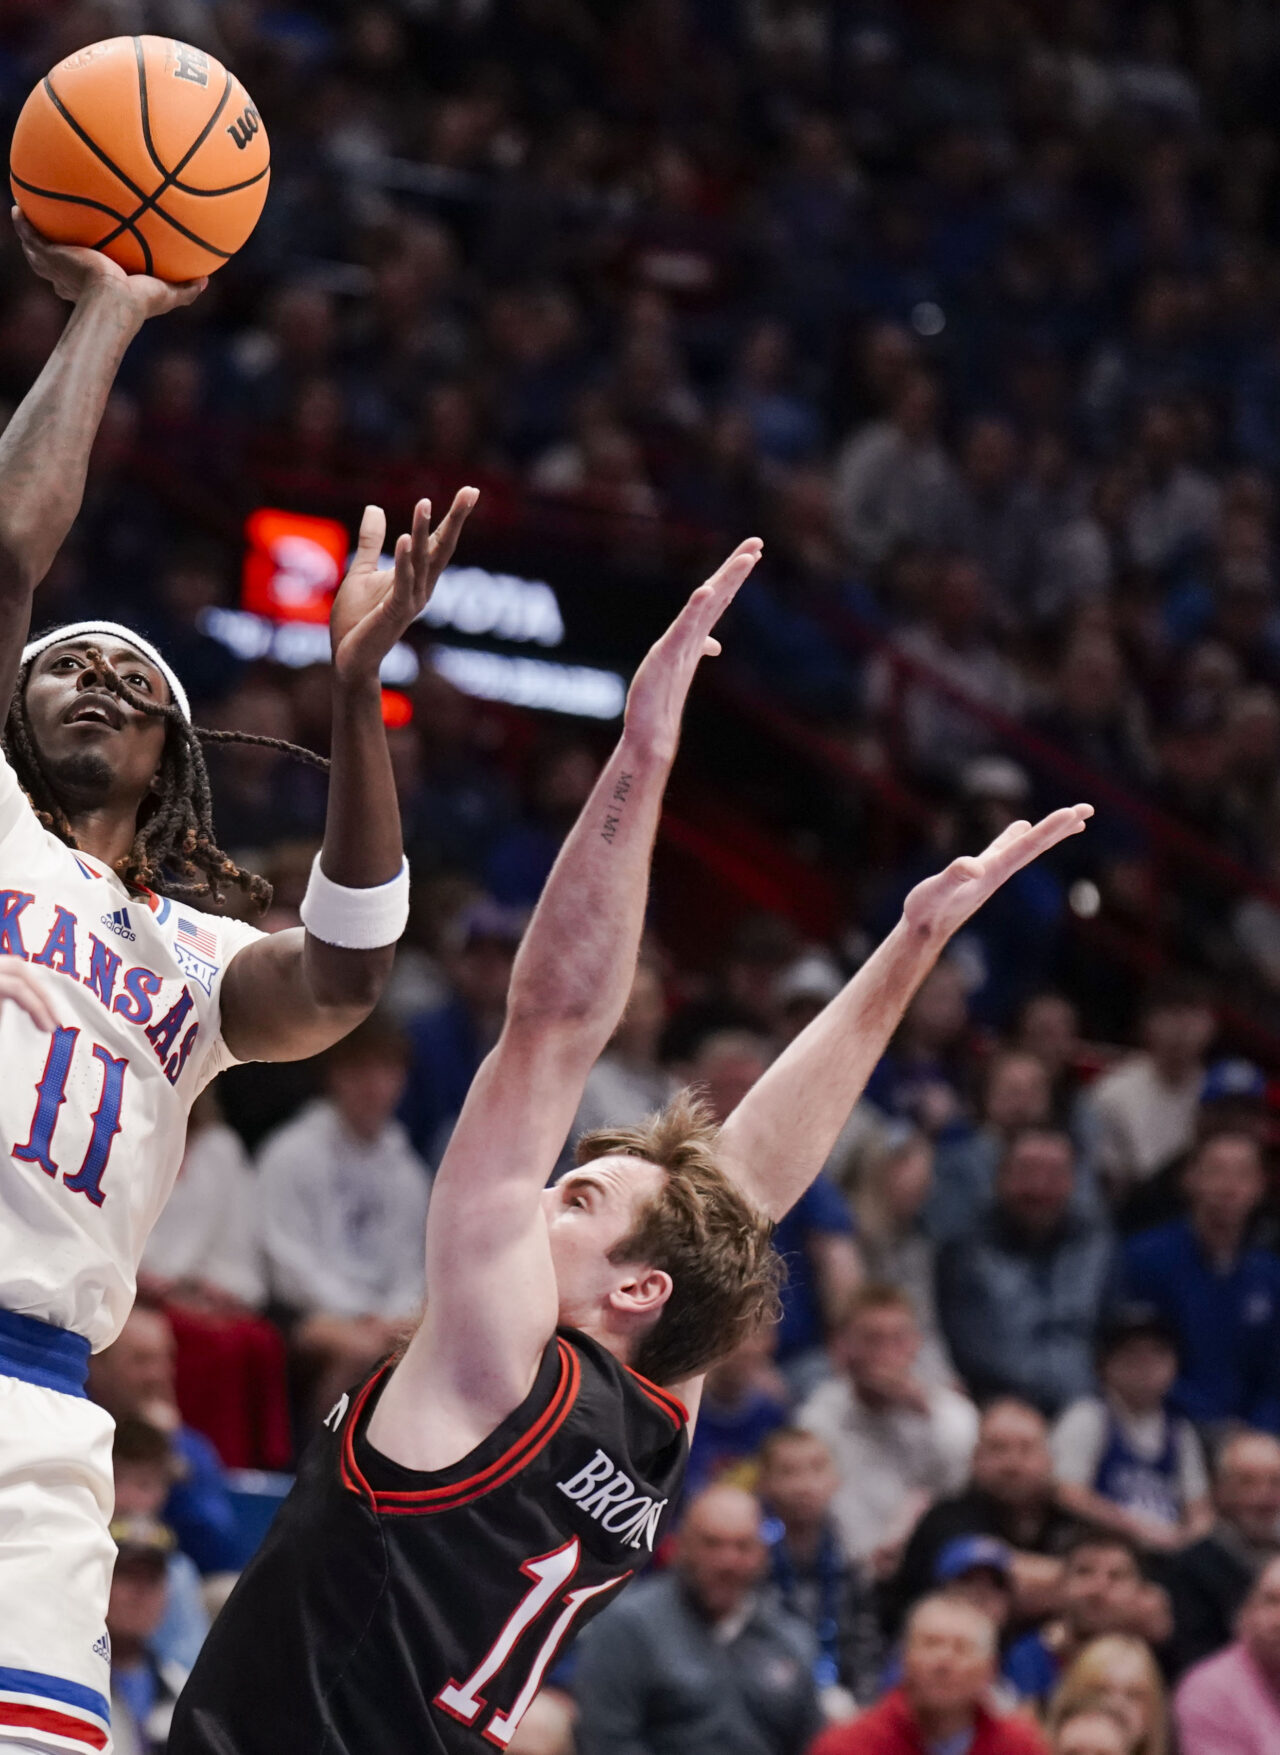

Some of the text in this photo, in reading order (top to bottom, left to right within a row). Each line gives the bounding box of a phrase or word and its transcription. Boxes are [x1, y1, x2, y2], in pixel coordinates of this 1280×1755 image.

[100, 913, 136, 942] adidas
[11, 1024, 129, 1208] 11
[432, 1533, 634, 1752] 11
